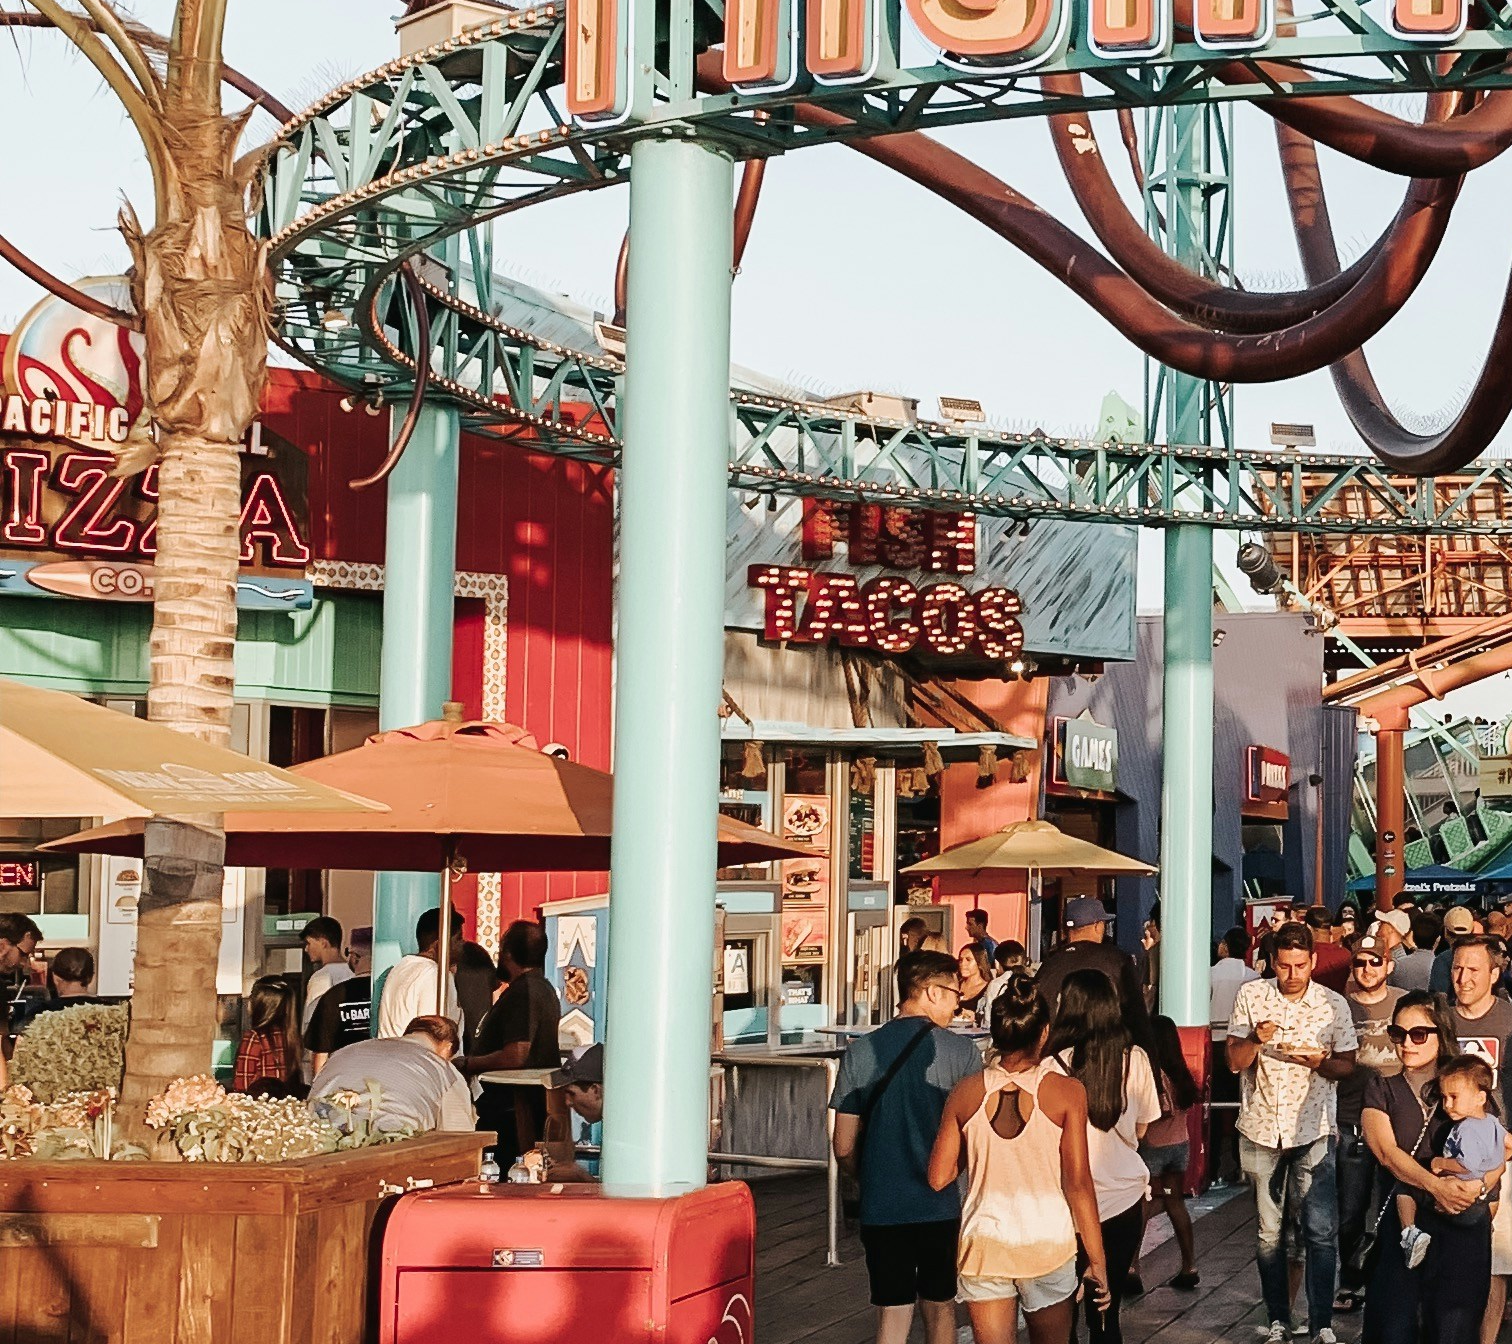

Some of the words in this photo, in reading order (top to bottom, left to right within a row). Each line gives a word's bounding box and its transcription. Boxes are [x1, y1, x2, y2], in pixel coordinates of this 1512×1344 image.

[0, 395, 129, 442] ACIFIC
[747, 562, 1026, 660] TACOS
[1071, 734, 1112, 774] GAMES
[1432, 881, 1477, 892] Pretzels
[730, 952, 745, 974] A
